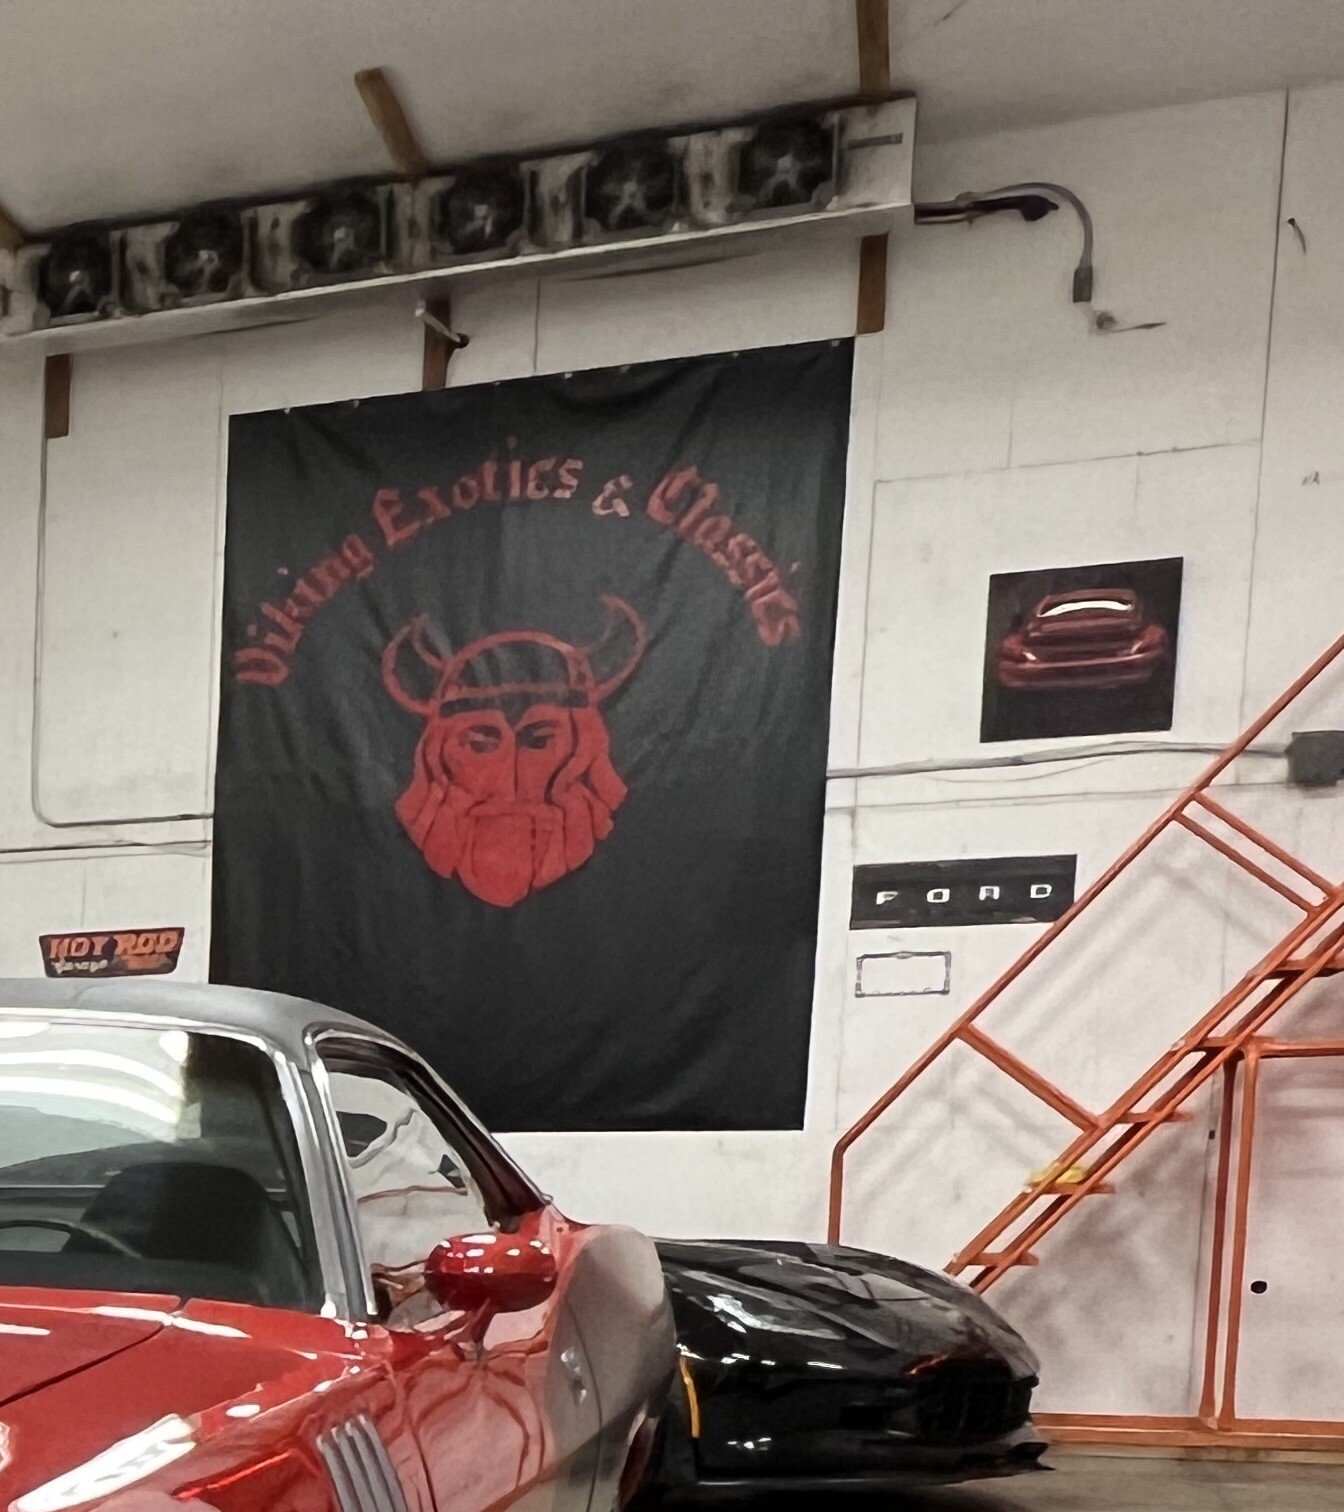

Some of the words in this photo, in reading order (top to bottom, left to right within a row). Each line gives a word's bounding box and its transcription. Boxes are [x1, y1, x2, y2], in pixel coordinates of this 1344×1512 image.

[591, 474, 634, 518] &
[875, 883, 1053, 906] FORD
[49, 936, 110, 959] HOT
[112, 931, 180, 956] ROD
